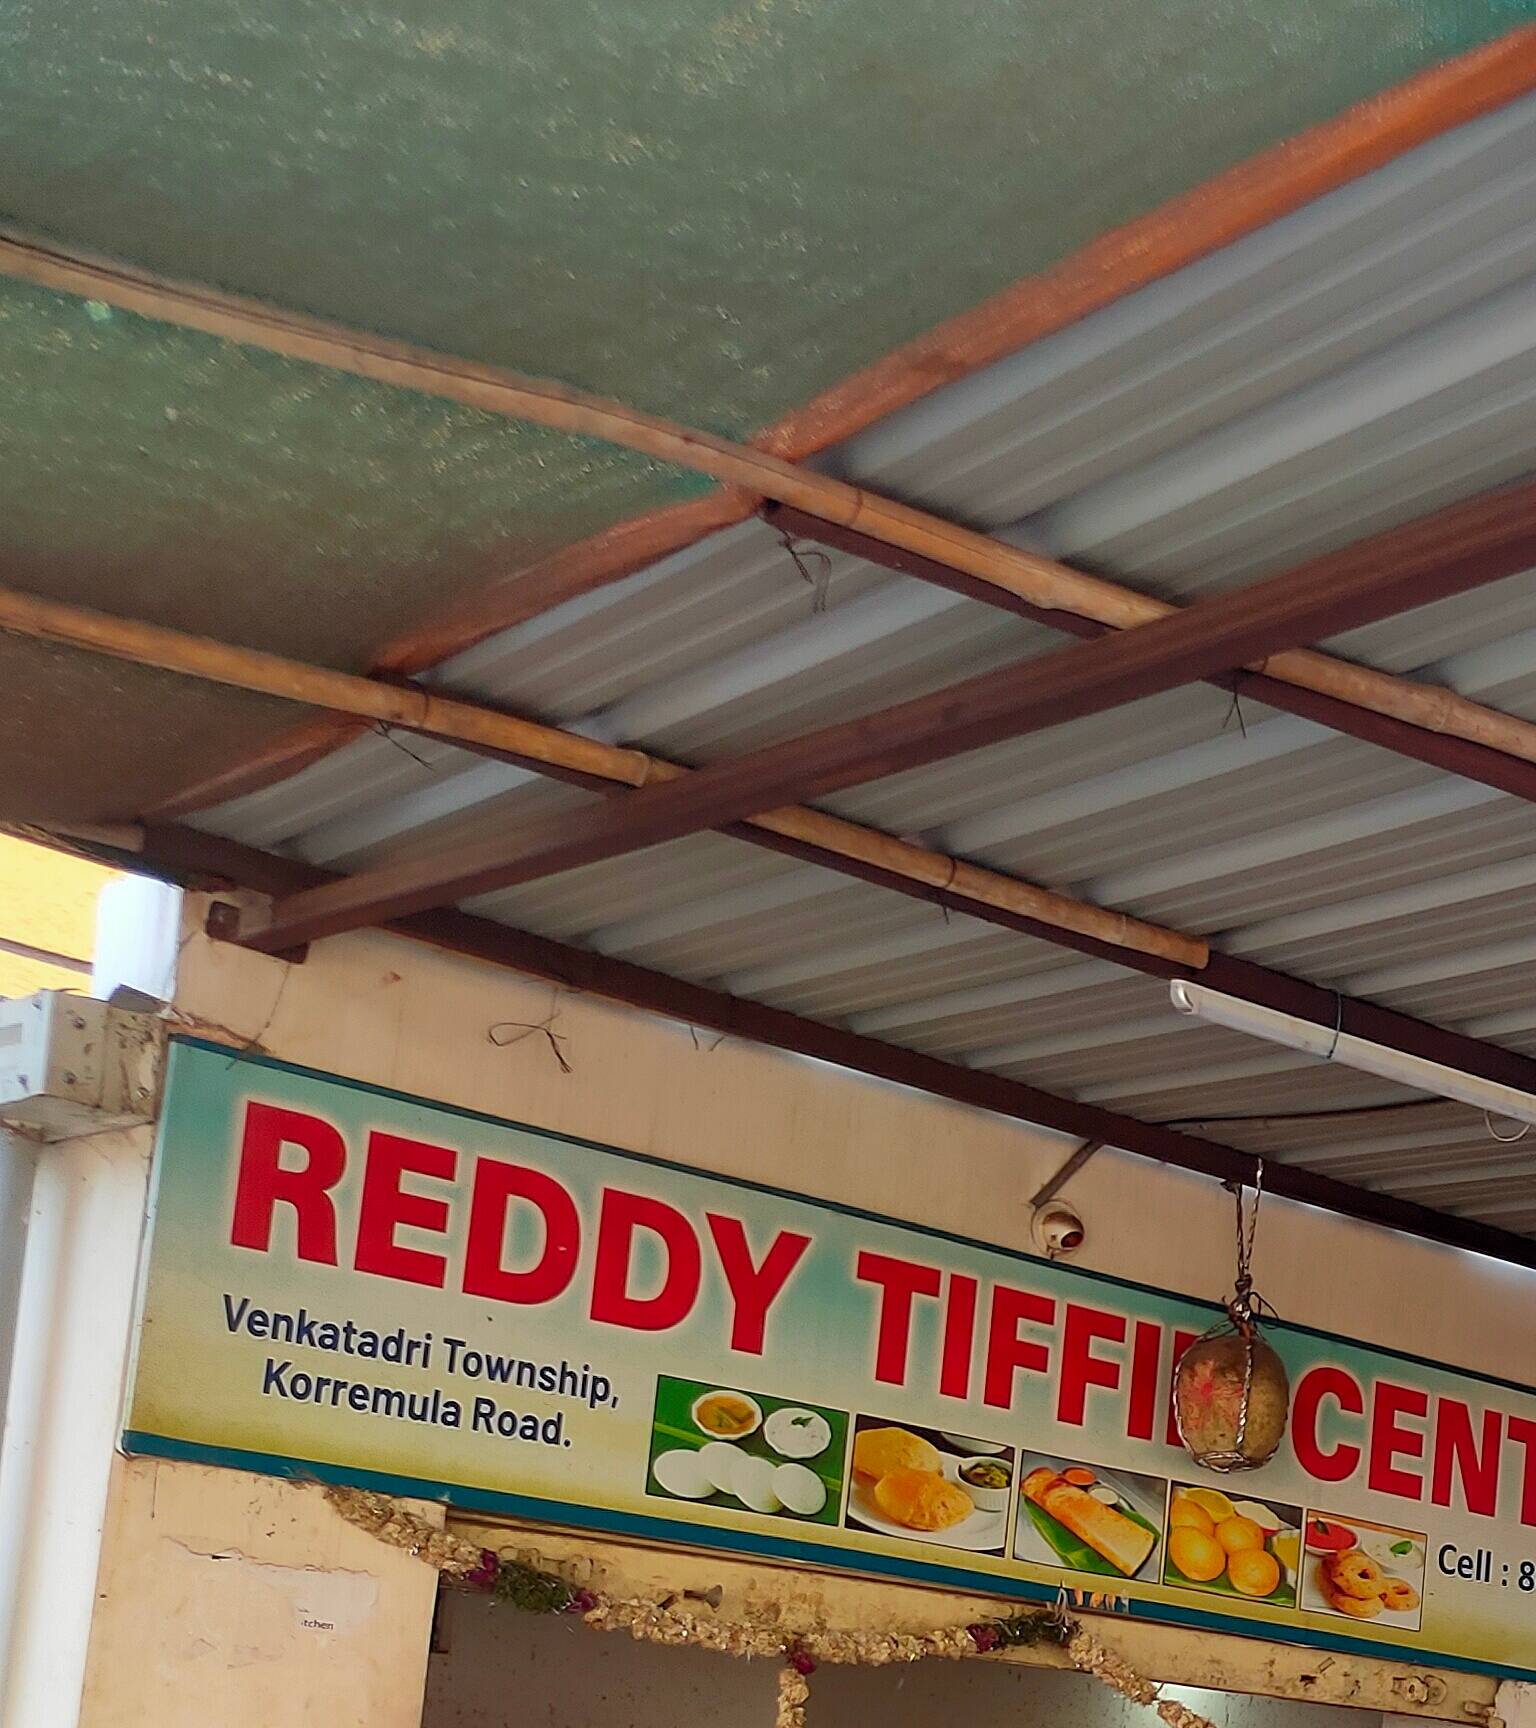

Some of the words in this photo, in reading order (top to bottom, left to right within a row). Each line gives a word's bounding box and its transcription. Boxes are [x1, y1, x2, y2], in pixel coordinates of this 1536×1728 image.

[231, 1101, 812, 1355] REDDY
[857, 1250, 1200, 1446] TIFFI
[223, 1295, 433, 1370] Venkatadri
[442, 1336, 620, 1410] Township,
[262, 1358, 461, 1428] Korremula
[472, 1396, 572, 1449] Road.
[1438, 1543, 1493, 1583] Cell
